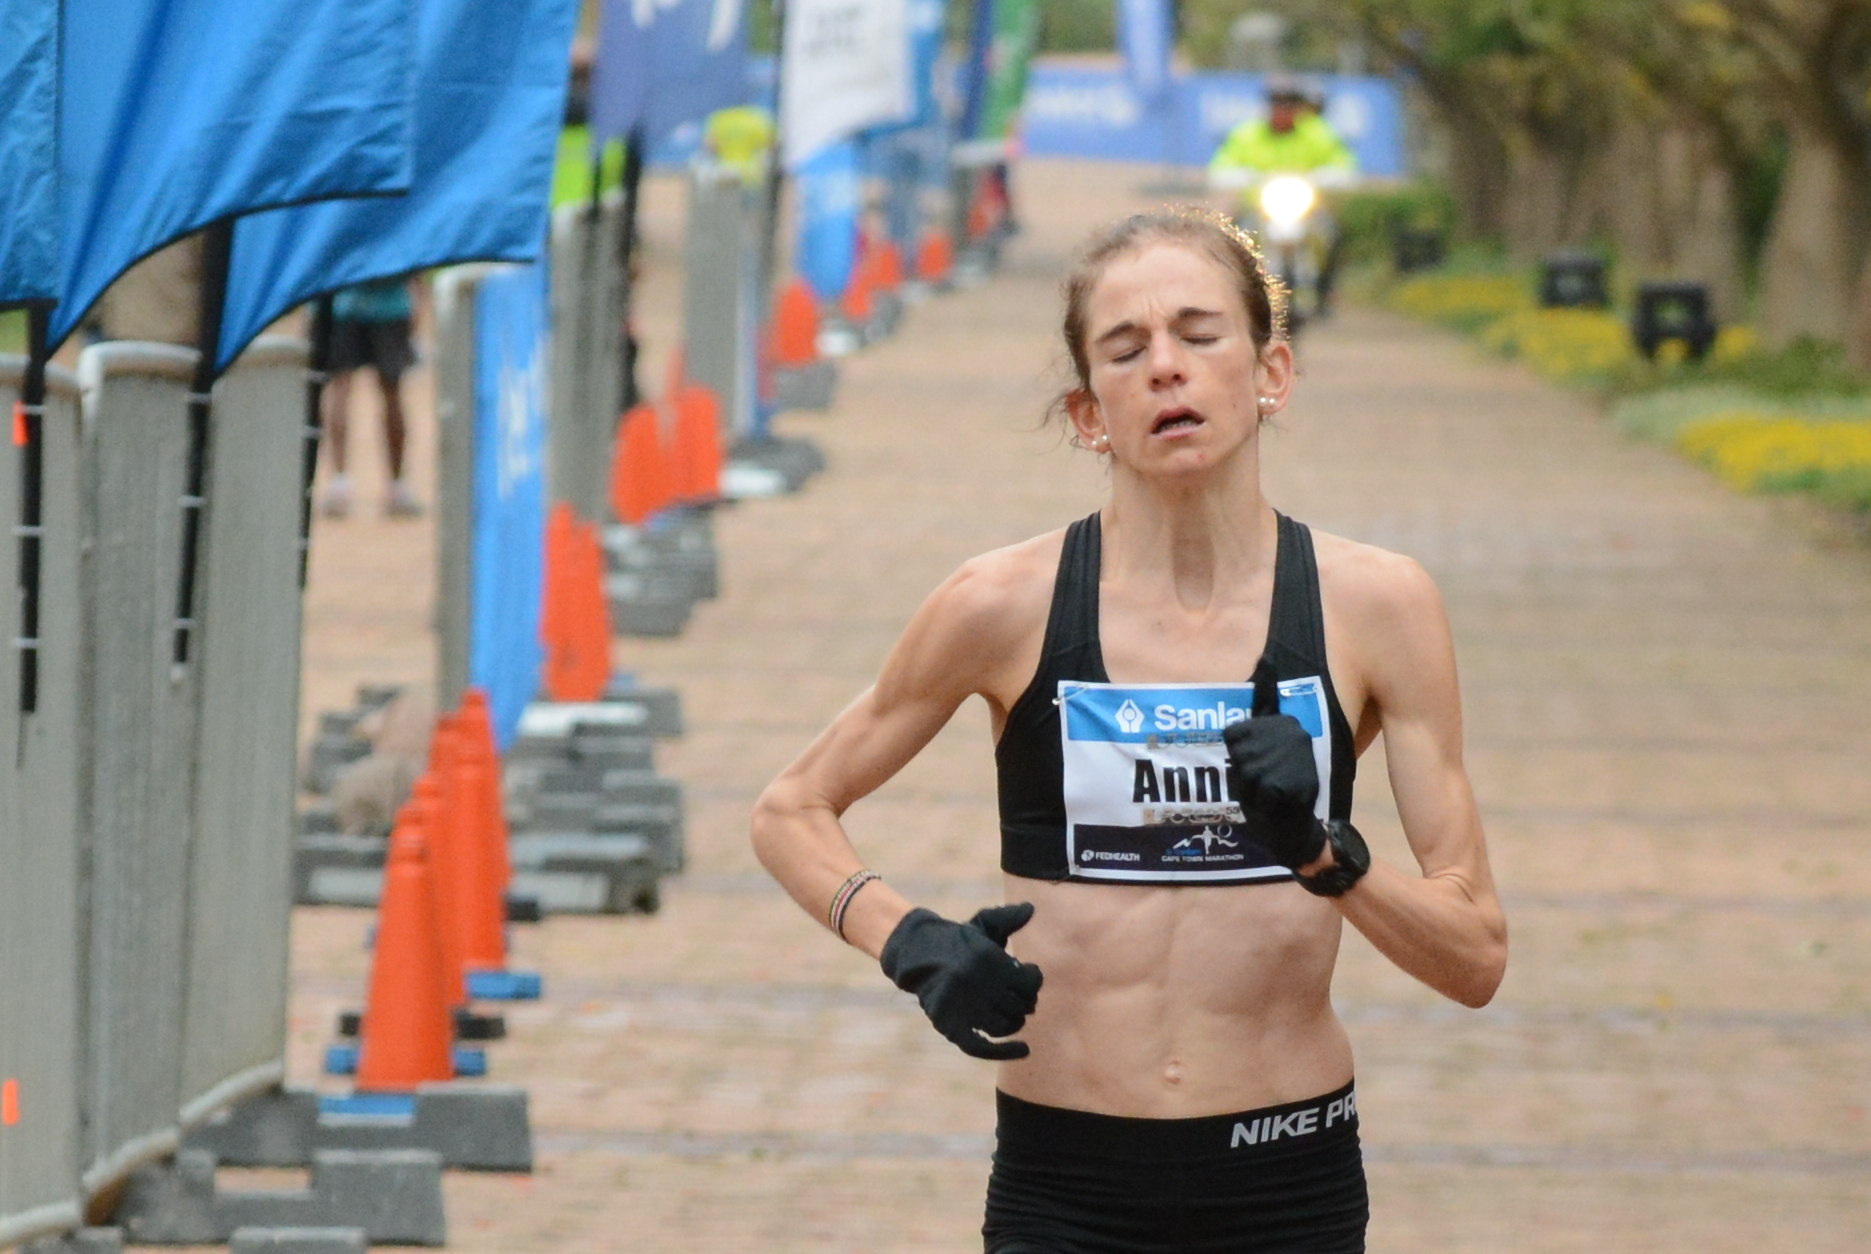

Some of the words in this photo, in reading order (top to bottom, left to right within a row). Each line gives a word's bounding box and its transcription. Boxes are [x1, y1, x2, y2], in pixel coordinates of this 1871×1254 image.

[1154, 701, 1252, 731] Sanla
[1132, 758, 1239, 803] Anni
[1095, 851, 1141, 862] FEDHEALTH
[1205, 854, 1243, 862] MARATHON
[1230, 1107, 1320, 1148] NIKE
[1326, 1091, 1356, 1128] PR
